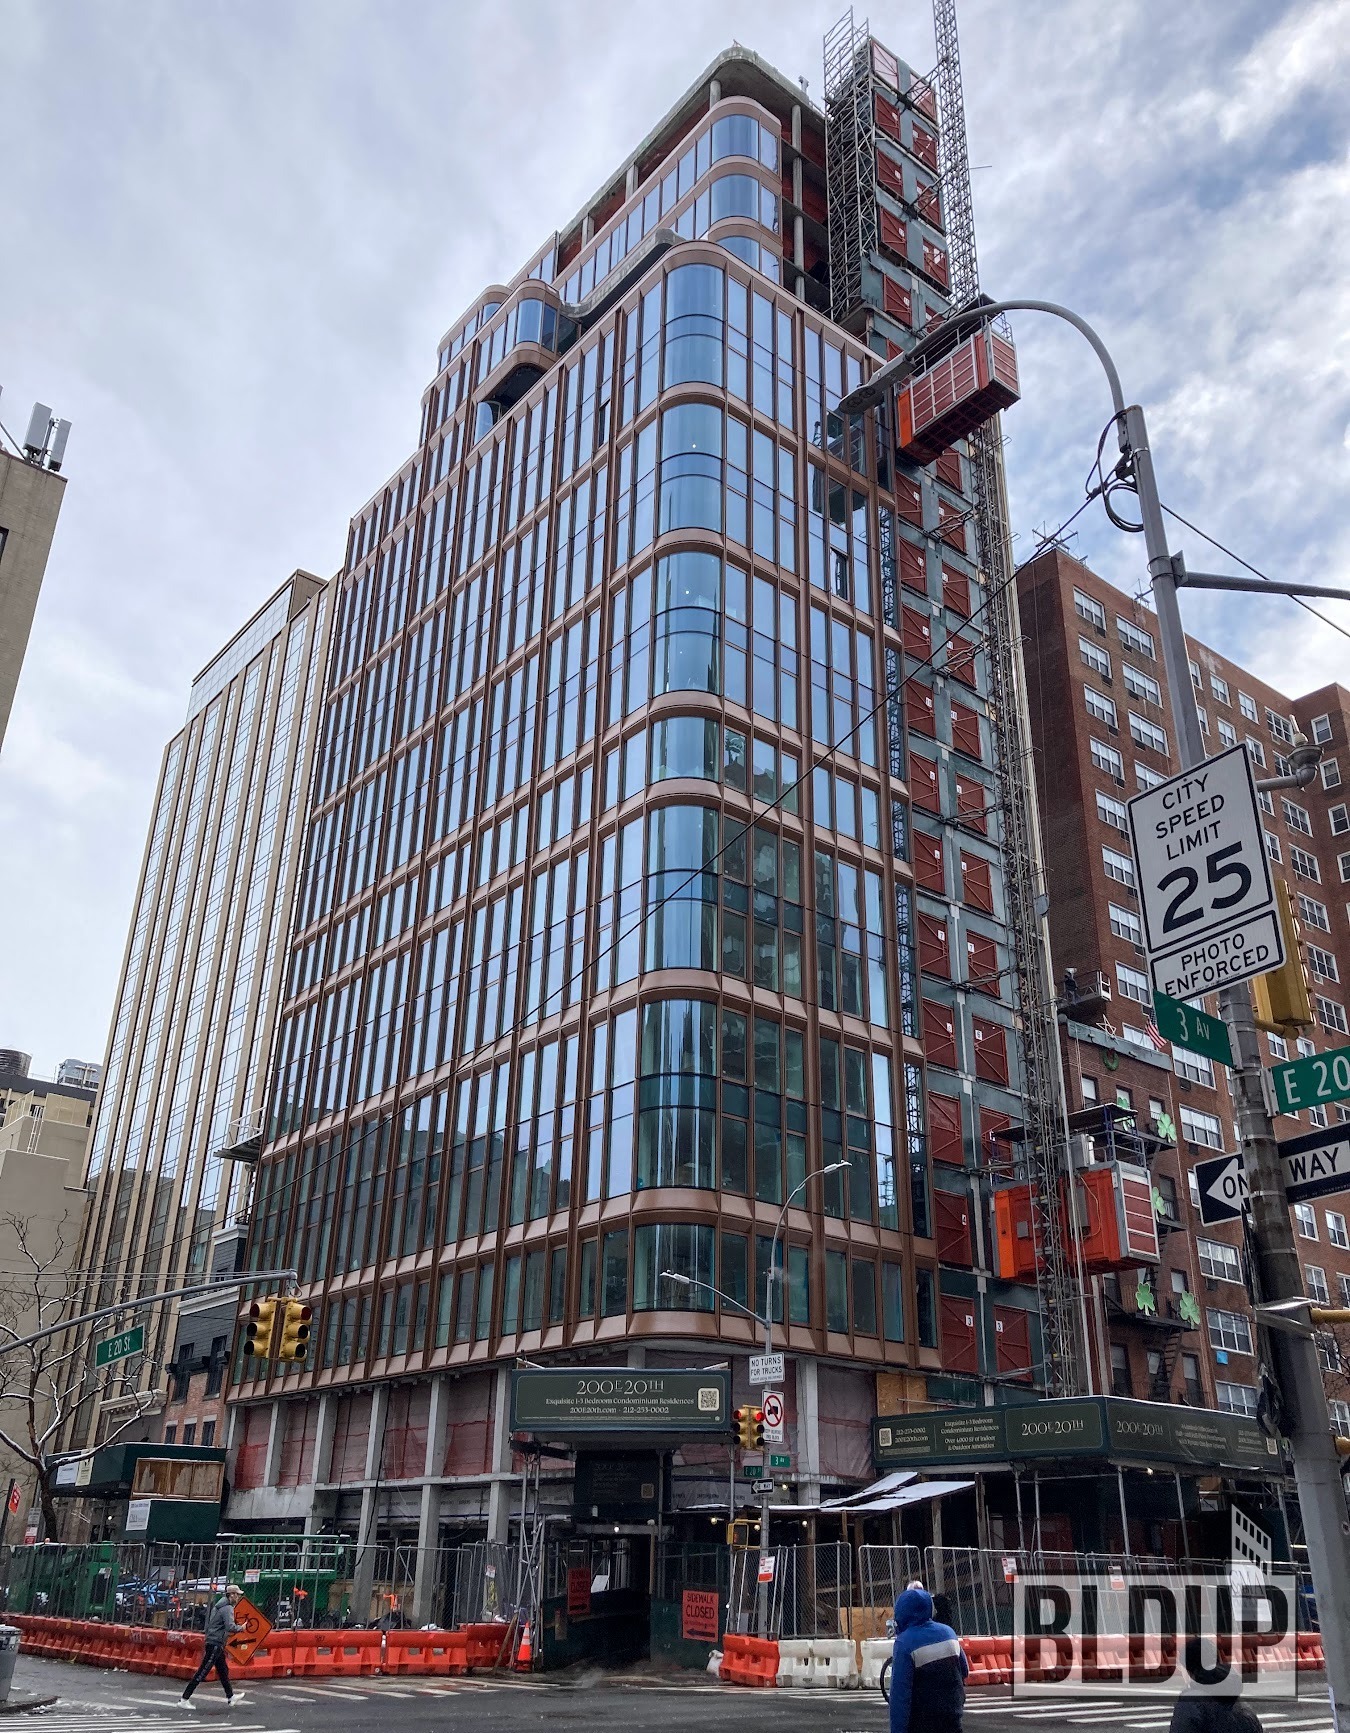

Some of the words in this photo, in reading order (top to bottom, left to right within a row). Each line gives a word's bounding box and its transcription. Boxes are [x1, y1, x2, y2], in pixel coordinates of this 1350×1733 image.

[1162, 773, 1209, 810] CITY
[1156, 794, 1225, 839] SPEED
[1166, 820, 1222, 861] LIMIT
[1157, 840, 1252, 934] 25
[1181, 933, 1245, 971] PHOTO
[1164, 944, 1269, 997] ENFORCED
[1176, 1007, 1189, 1042] 3
[1283, 1068, 1301, 1105] E
[1312, 1055, 1350, 1097] 20
[1288, 1146, 1339, 1183] WAY
[108, 1342, 112, 1358] E
[114, 1339, 122, 1355] 20
[123, 1336, 130, 1351] St
[751, 1359, 759, 1367] NO
[761, 1356, 781, 1366] TURNS
[750, 1368, 760, 1377] FOR
[762, 1365, 783, 1375] TRUCKS
[545, 1398, 574, 1406] Exquisite
[569, 1406, 617, 1414] 200E20th.com
[623, 1406, 670, 1414] 212-253-0002
[775, 1456, 779, 1466] 3
[685, 1604, 715, 1620] CLOSED
[687, 1592, 715, 1604] SIDEWALK
